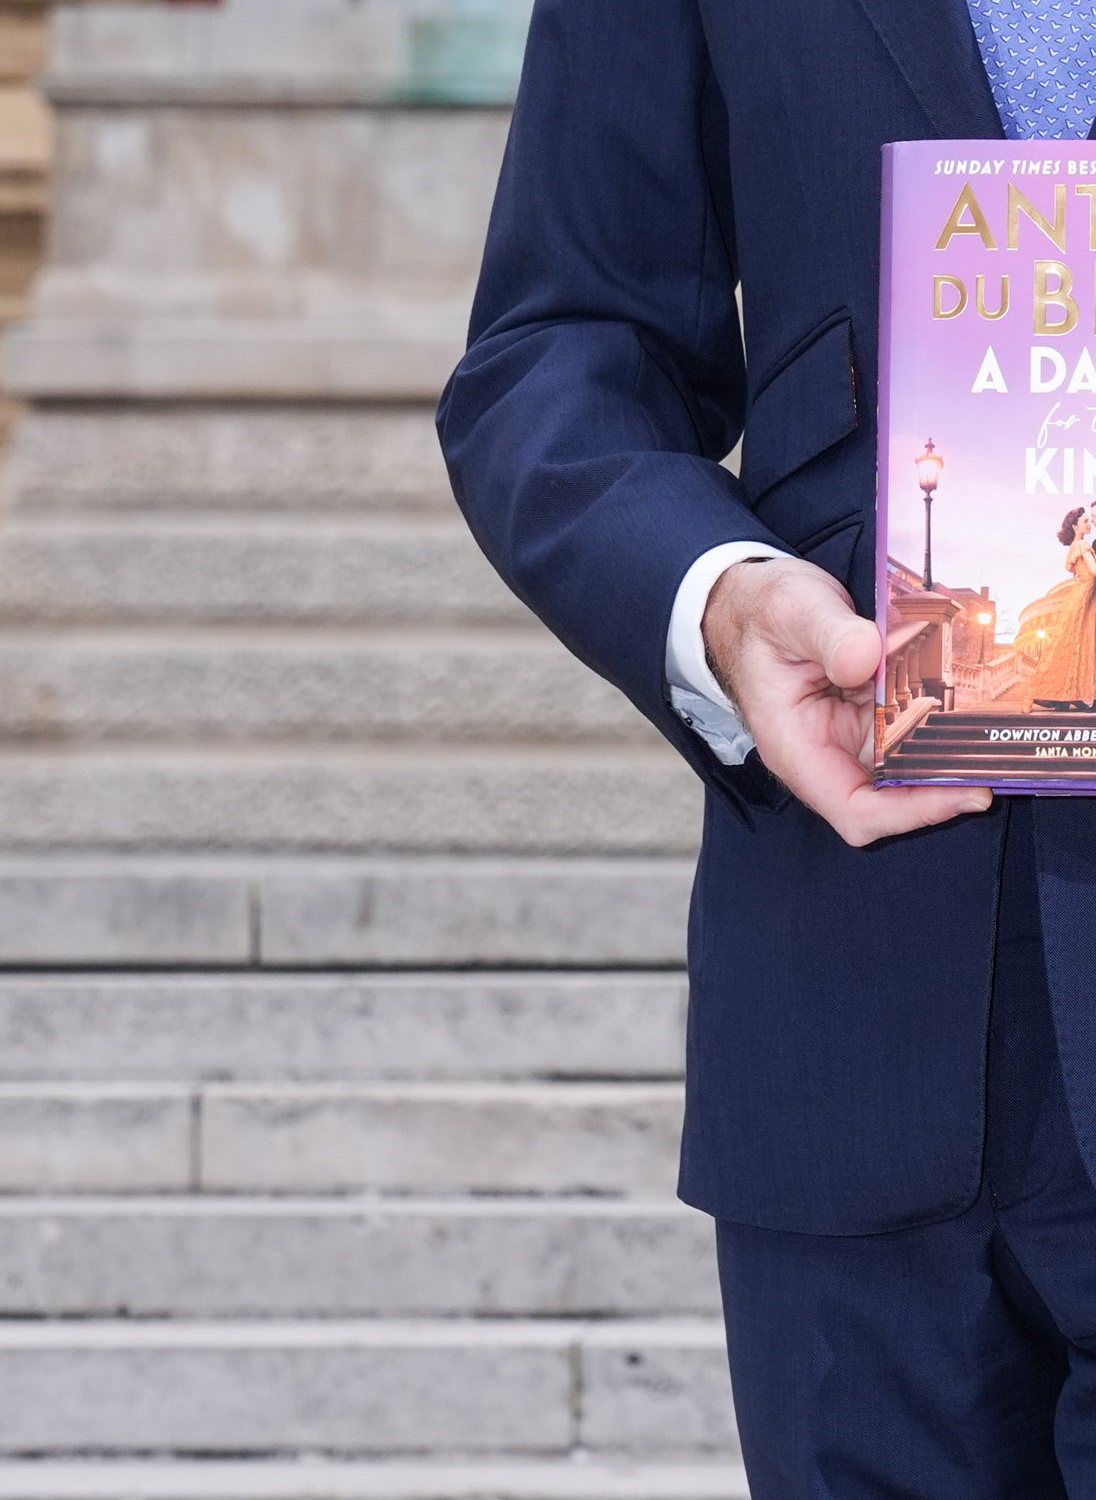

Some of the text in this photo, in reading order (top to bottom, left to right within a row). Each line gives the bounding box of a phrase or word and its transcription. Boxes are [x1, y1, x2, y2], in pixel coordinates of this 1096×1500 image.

[934, 160, 1005, 175] SUNDAY
[1011, 160, 1060, 175] TIMES
[933, 274, 1010, 320] DU
[971, 345, 1008, 393] A
[1037, 402, 1080, 448] for
[1035, 747, 1069, 757] SANTA
